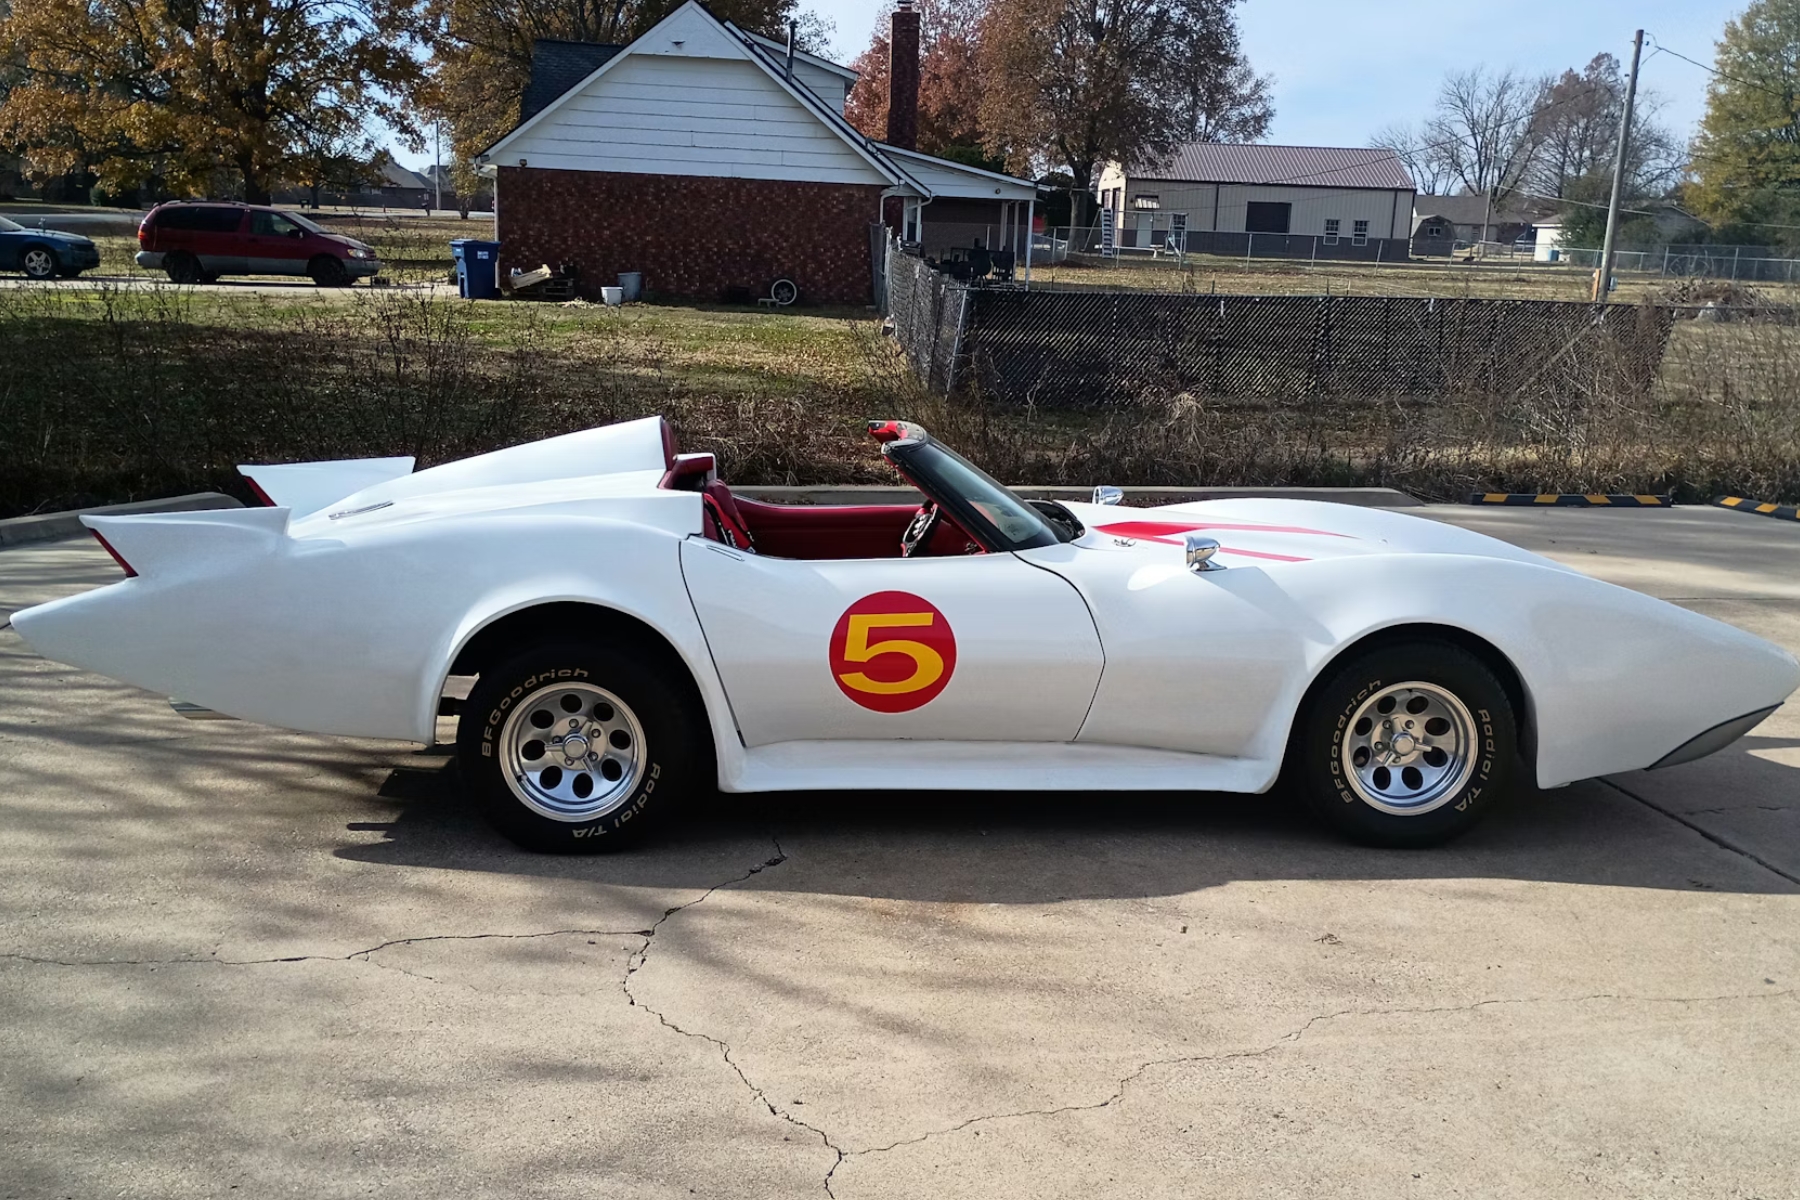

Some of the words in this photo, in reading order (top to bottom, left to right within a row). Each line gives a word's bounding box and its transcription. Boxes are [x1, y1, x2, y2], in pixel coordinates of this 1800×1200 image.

[838, 612, 944, 695] 5
[482, 668, 589, 757] BFGoodrich
[1330, 679, 1382, 804] BFGoodrich
[1477, 708, 1496, 781] Radial
[571, 825, 607, 838] T/A
[614, 762, 661, 828] Radial
[1454, 787, 1482, 812] T/A
